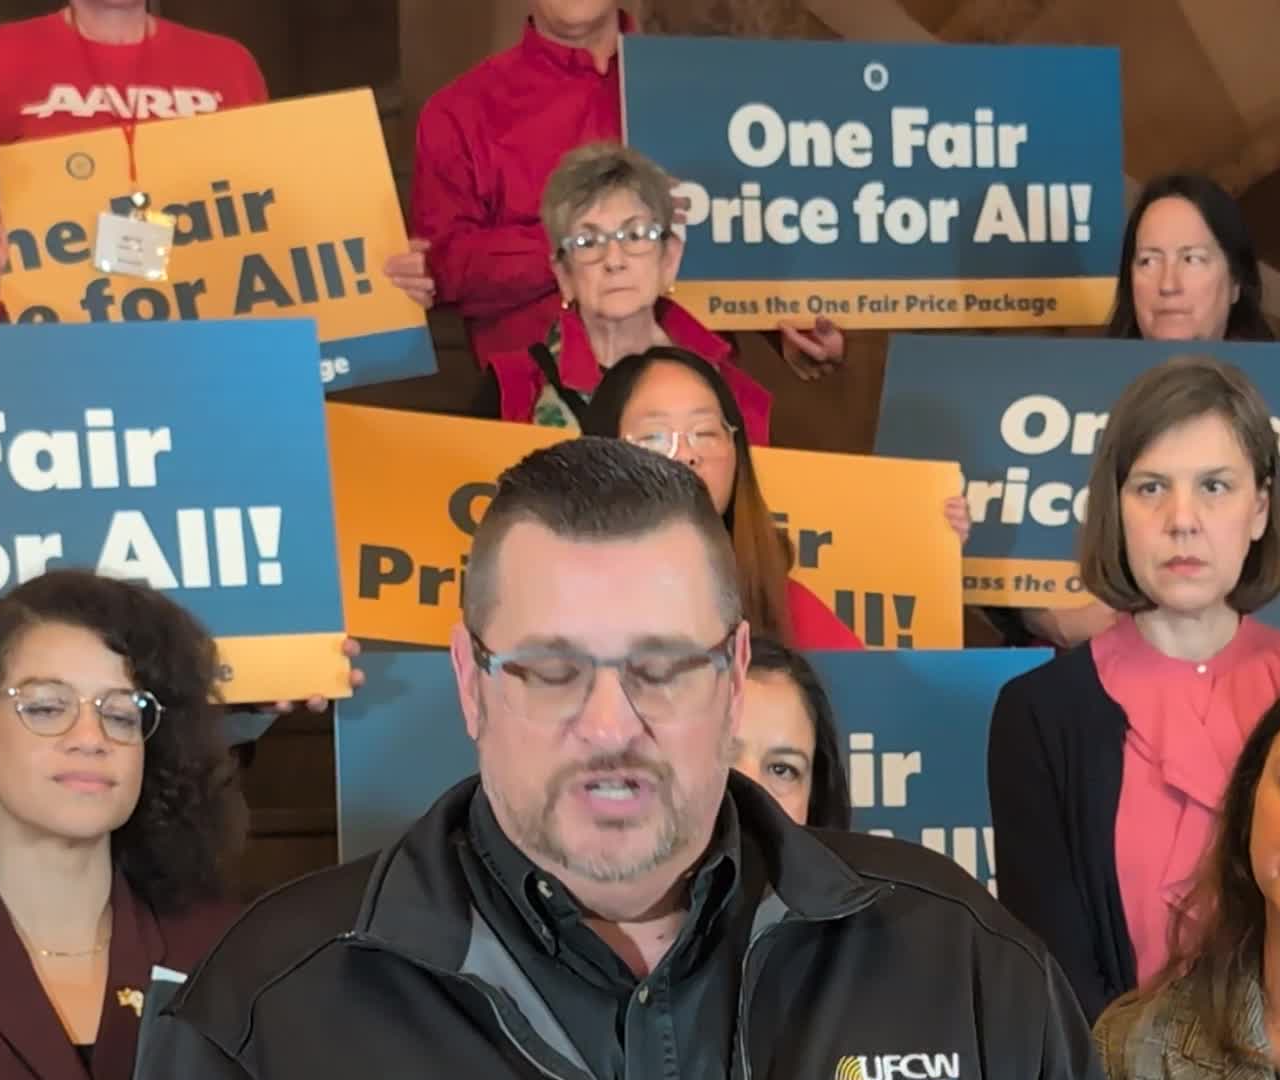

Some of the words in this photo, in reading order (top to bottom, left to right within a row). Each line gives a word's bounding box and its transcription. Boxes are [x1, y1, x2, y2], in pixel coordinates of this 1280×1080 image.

[727, 103, 873, 168] One
[890, 107, 1028, 169] Fair
[2, 221, 91, 272] ne
[110, 180, 275, 246] air
[669, 181, 839, 244] Price
[853, 180, 959, 244] for
[973, 183, 1093, 243] All!
[80, 278, 208, 322] for
[234, 238, 373, 315] All!
[709, 295, 763, 314] Pass
[767, 295, 801, 313] the
[806, 294, 850, 314] One
[857, 294, 899, 313] Fair
[906, 294, 959, 313] Price
[964, 293, 1057, 316] Package
[965, 467, 1090, 526] ric
[95, 506, 284, 591] All!
[963, 575, 1005, 590] ass
[1014, 574, 1057, 592] the
